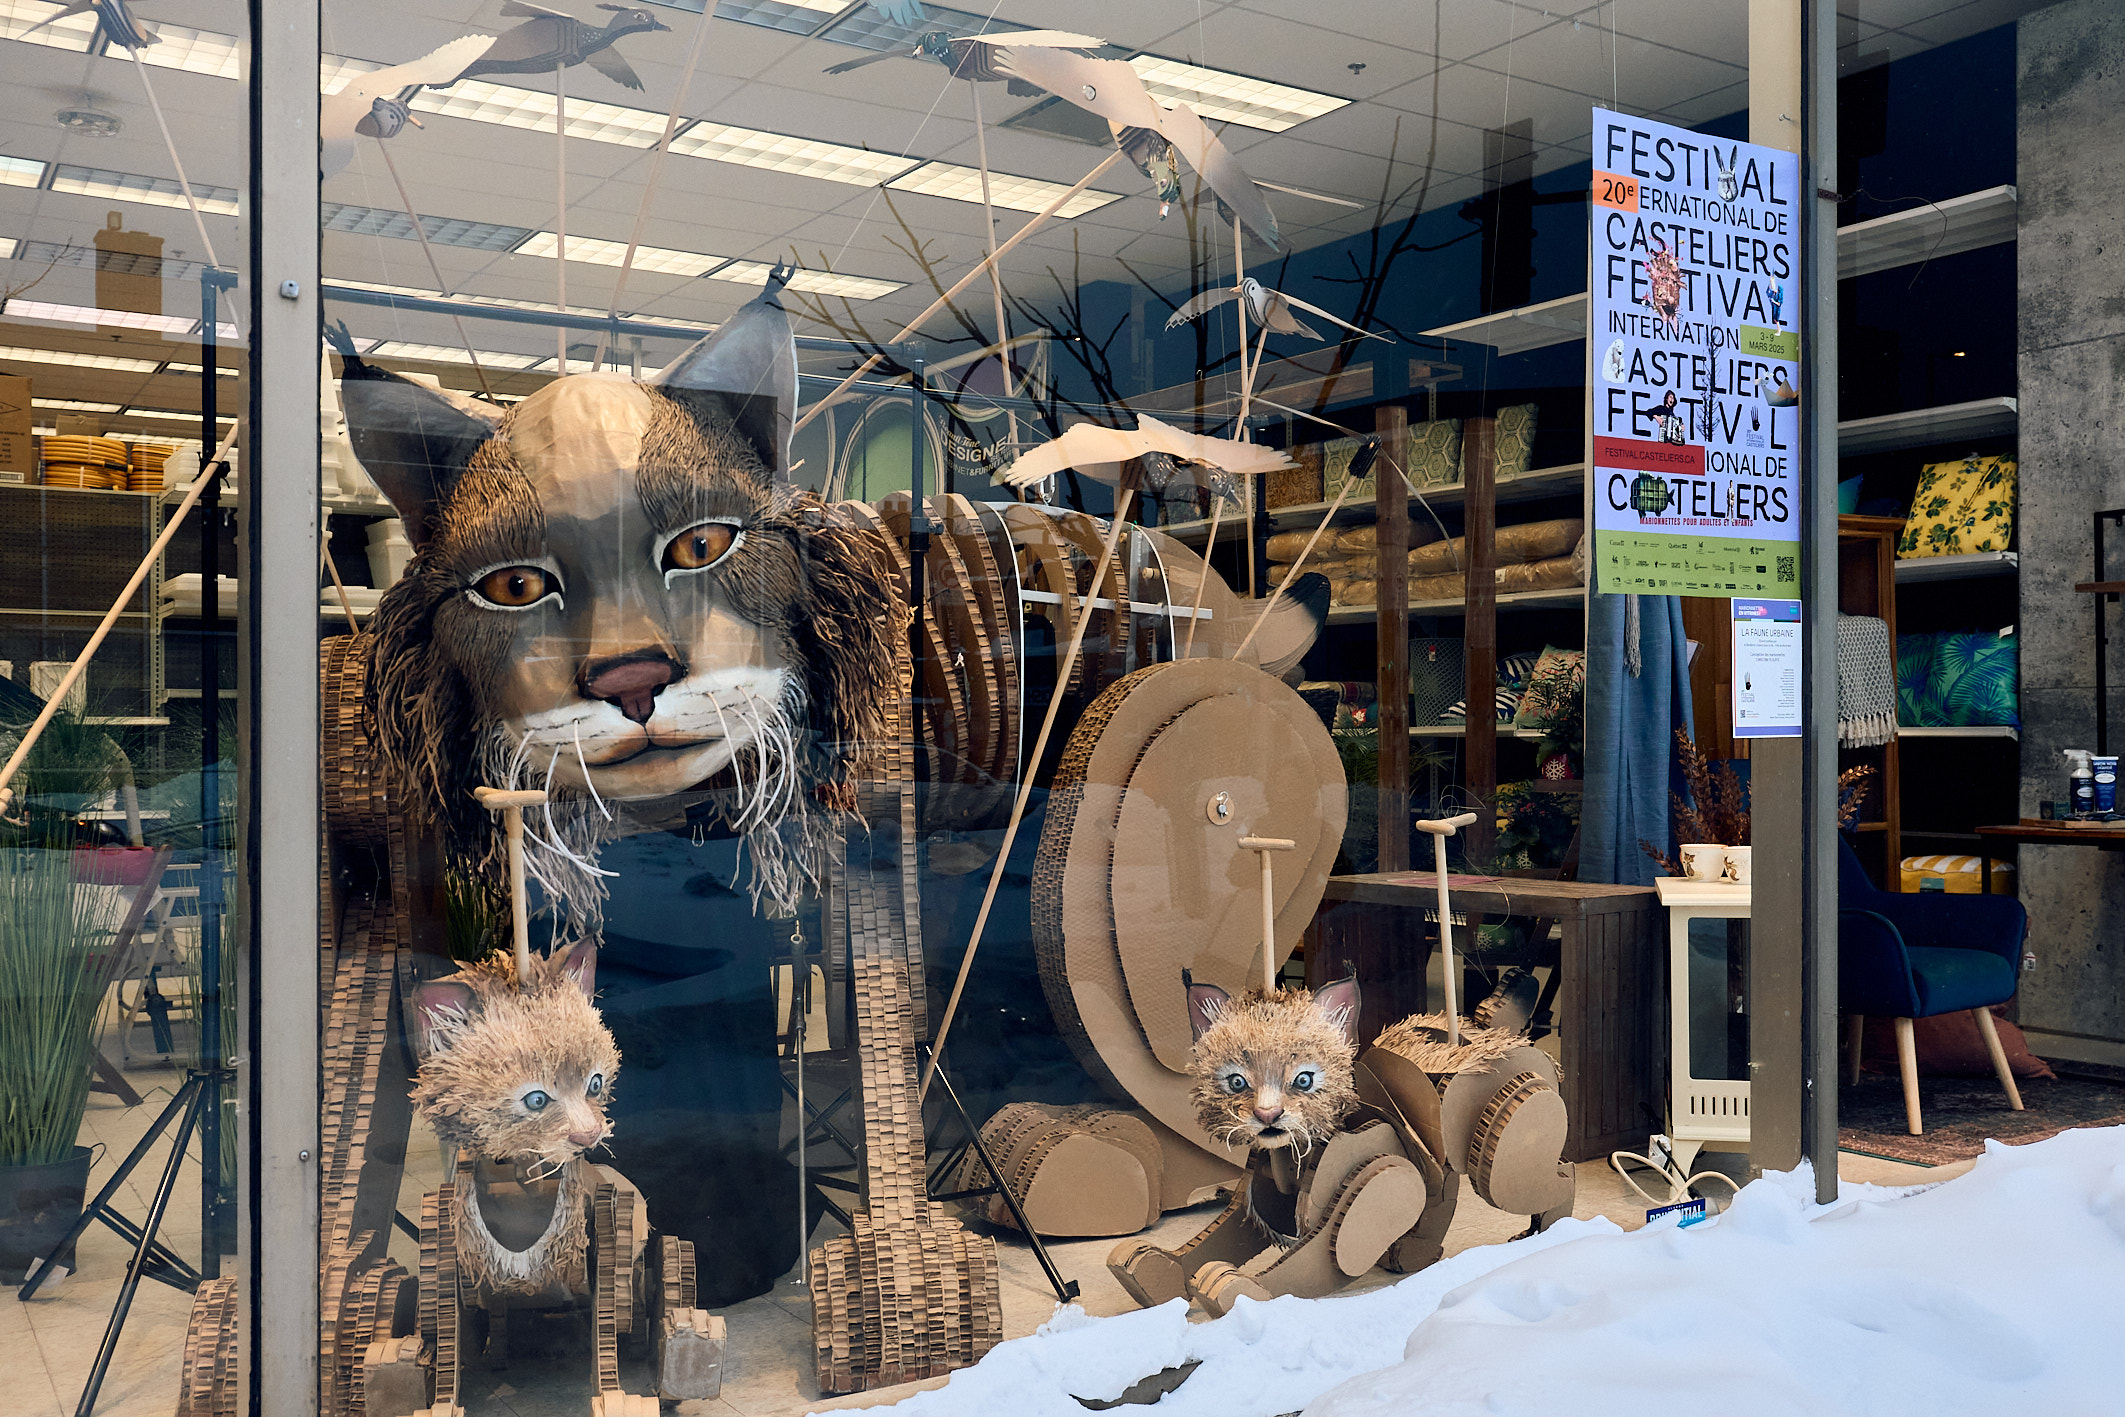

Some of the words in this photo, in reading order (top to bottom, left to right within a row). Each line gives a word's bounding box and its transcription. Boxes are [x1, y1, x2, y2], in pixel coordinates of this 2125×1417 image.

[1602, 178, 1635, 206] 20e
[1640, 186, 1761, 231] ERNATIONAL
[1764, 211, 1788, 236] DE
[1606, 212, 1790, 280] CASTELIERS
[1607, 254, 1788, 327] FETIVAL
[1748, 340, 1768, 352] MARS
[1768, 343, 1785, 354] 2025
[1627, 348, 1789, 399] ASTELIERS
[1607, 388, 1787, 450] FETIVL
[1605, 447, 1695, 464] FESTIVAL.CASTELIERS.CA
[1706, 450, 1762, 476] IONAL
[1765, 457, 1788, 479] DE
[1683, 518, 1698, 526] POUR
[1699, 519, 1722, 527] ADULTES
[1742, 629, 1750, 637] LA
[1751, 629, 1769, 637] FAUNE
[1770, 629, 1794, 638] URBAINE
